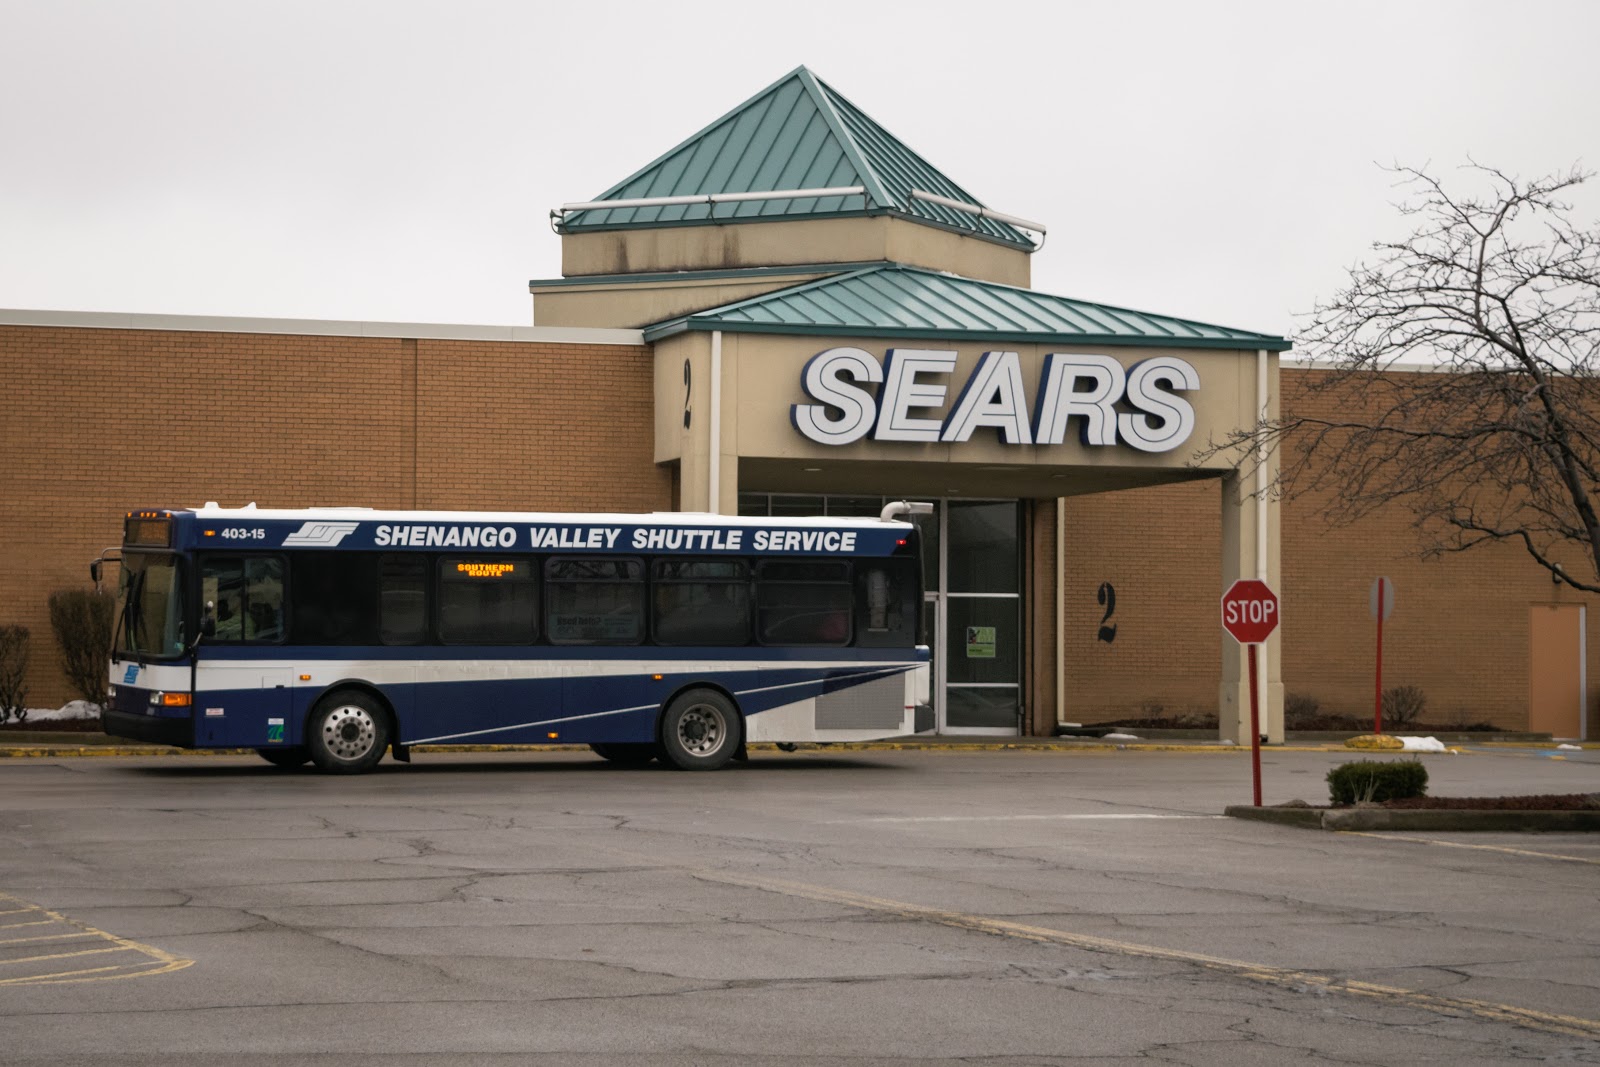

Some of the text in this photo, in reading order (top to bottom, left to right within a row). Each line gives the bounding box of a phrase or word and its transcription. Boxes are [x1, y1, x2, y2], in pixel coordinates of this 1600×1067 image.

[790, 346, 1200, 453] SEARS
[221, 528, 265, 539] 403-15
[374, 525, 517, 547] SHENANGO
[530, 527, 621, 548] VALLEY
[632, 528, 743, 550] SHUTTLE
[753, 530, 857, 551] SERVICE
[457, 563, 514, 572] SOUTHERN
[1097, 581, 1117, 644] 2
[1226, 599, 1275, 624] STOP
